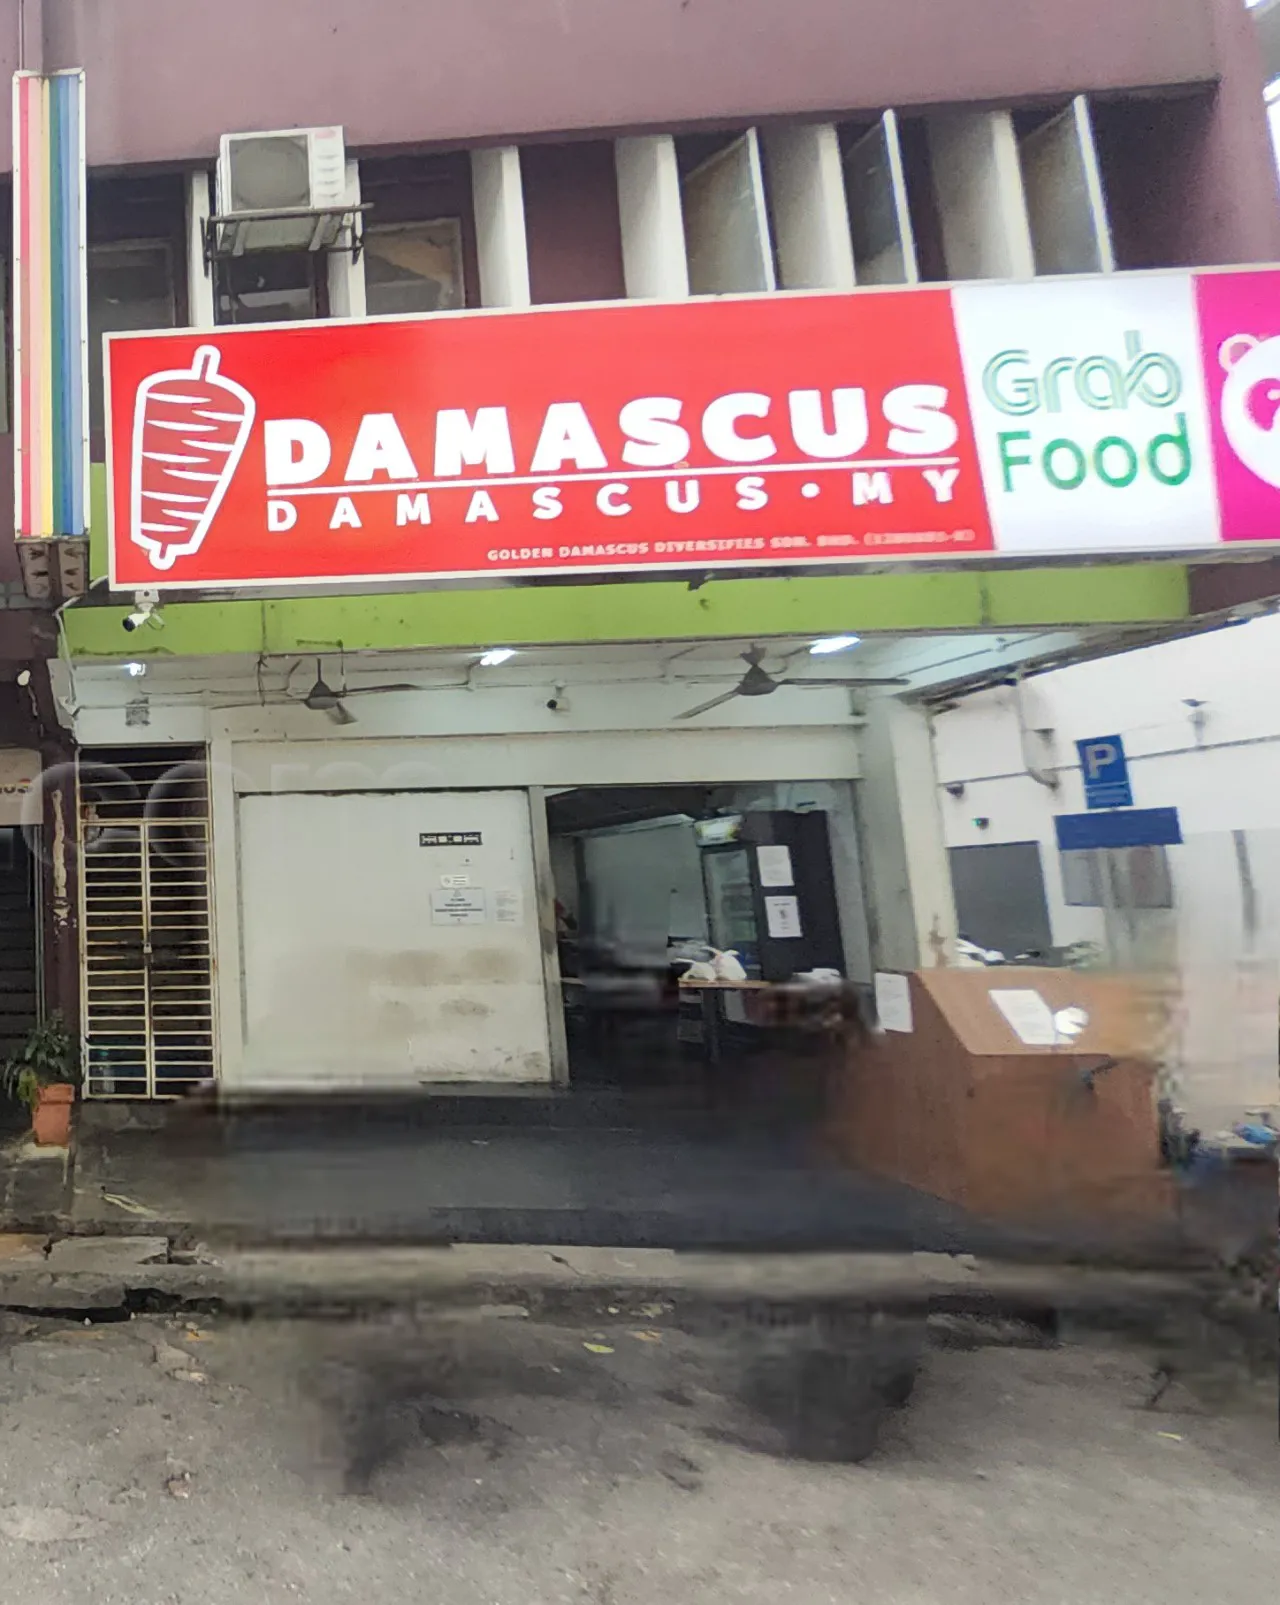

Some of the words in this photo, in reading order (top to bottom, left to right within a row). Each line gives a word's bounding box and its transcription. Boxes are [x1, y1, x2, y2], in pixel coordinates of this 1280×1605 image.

[983, 330, 1183, 417] Grab
[265, 384, 959, 485] DAMASCUS
[999, 414, 1192, 492] Food
[486, 547, 554, 561] GOLDEN
[558, 542, 650, 558] DAMASCUS
[1085, 743, 1117, 779] P
